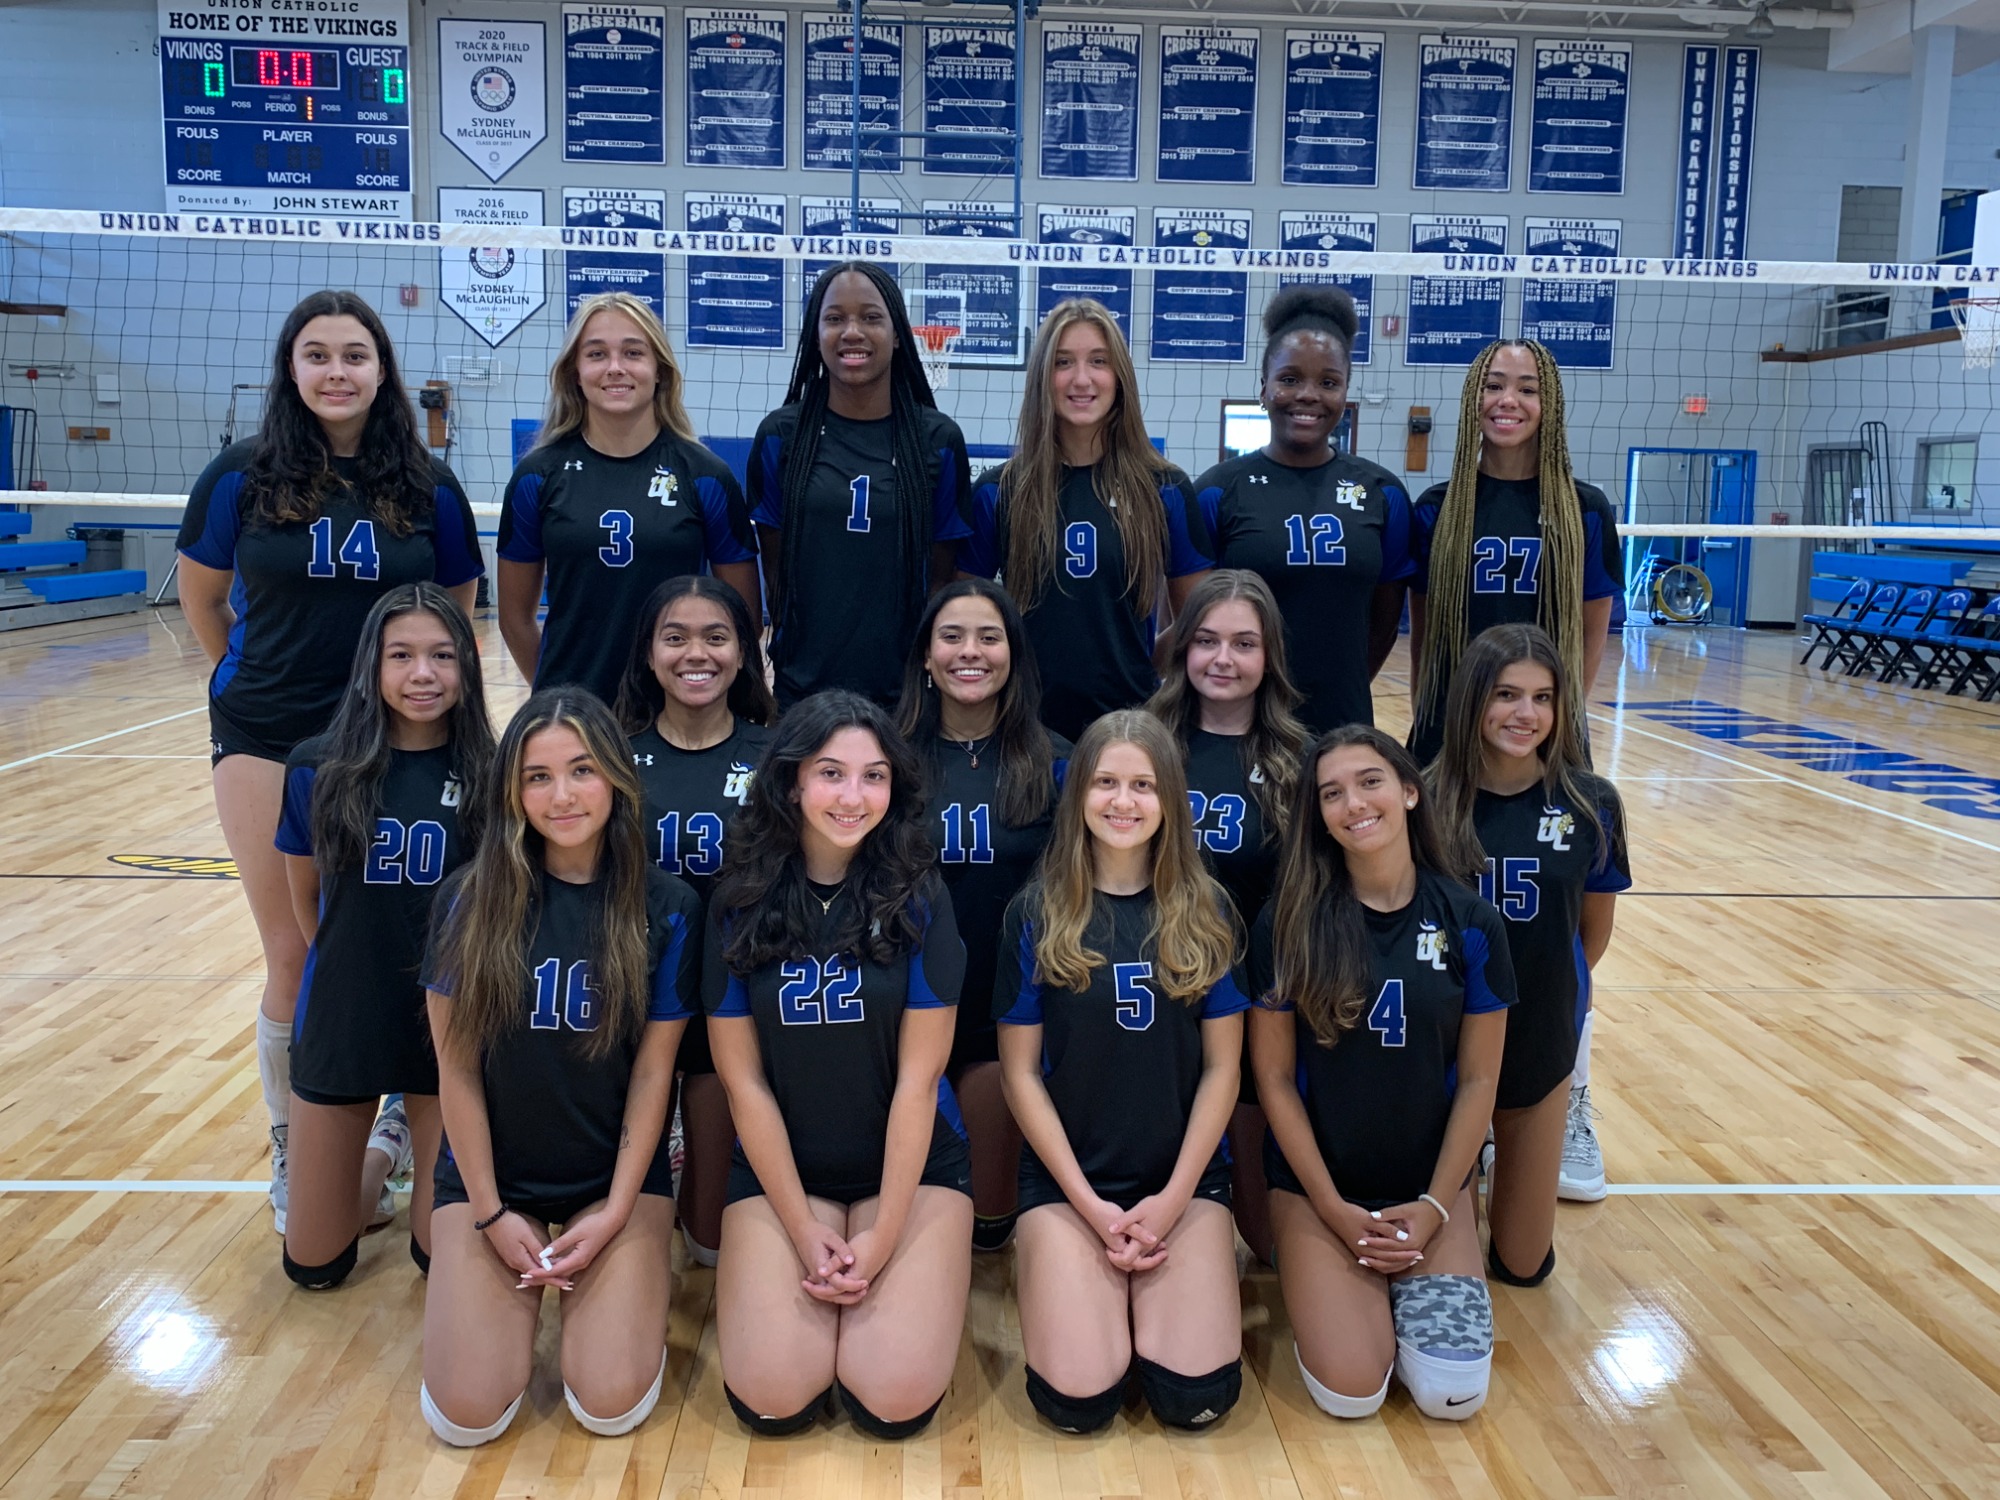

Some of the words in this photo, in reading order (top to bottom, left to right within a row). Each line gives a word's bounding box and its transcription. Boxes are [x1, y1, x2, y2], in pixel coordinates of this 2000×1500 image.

[208, 0, 262, 9] UNION
[271, 0, 359, 12] CATHOLIC
[169, 12, 229, 31] HOME
[236, 15, 263, 32] OF
[269, 16, 308, 33] THE
[314, 18, 398, 37] VIKINGS
[479, 30, 506, 40] 2020
[567, 14, 661, 39] BASEBALL
[690, 19, 783, 43] BASKETBALL
[807, 23, 900, 48] BASKEBALL
[166, 41, 223, 61] VIKINGS
[455, 41, 488, 51] TRACK
[491, 42, 500, 51] &
[503, 42, 530, 52] FIELD
[1047, 32, 1083, 52] CROSS
[1086, 33, 1138, 55] COUNTRY
[1165, 37, 1201, 57] CROSS
[1204, 38, 1255, 59] COUNTRY
[1290, 41, 1380, 60] GOLF
[346, 48, 402, 67] GUEST
[463, 53, 523, 63] OLYMPIAN
[1424, 46, 1513, 68] GYMNASTICS
[1538, 50, 1627, 74] SOCCER
[204, 63, 225, 97] 0
[384, 69, 404, 104] 0
[1690, 51, 1708, 132] UNION
[184, 106, 215, 116] BONUS
[231, 101, 251, 109] POSS
[265, 102, 297, 113] PERIOD
[321, 104, 341, 112] POSS
[357, 112, 388, 121] BONUS
[471, 118, 516, 128] SYDNEY
[177, 127, 219, 140] FOULS
[263, 129, 313, 143] PLAYER
[356, 133, 397, 145] FOULS
[457, 128, 531, 139] McLAUGHLIN
[1725, 52, 1748, 211] CHAMPIONSHIP
[177, 169, 222, 181] SCORE
[267, 172, 311, 184] MATCH
[356, 174, 399, 187] SCORE
[178, 195, 228, 205] Donated
[234, 197, 251, 207] By:
[273, 196, 316, 210] JOHN
[322, 198, 399, 211] STEWART
[454, 209, 487, 218] TRACK
[490, 210, 499, 218] &
[501, 210, 529, 219] FIELD
[478, 198, 504, 208] 2016
[567, 198, 661, 222] SOCCER
[826, 199, 873, 207] VIKIGS
[690, 203, 782, 226] SOFTBALL
[806, 207, 835, 227] SPRING
[99, 212, 180, 232] UNION
[195, 216, 321, 236] CATHOLIC
[339, 220, 441, 240] VIKINGS
[1042, 215, 1132, 237] SWIMMING
[1159, 219, 1248, 240] TENNIS
[1284, 222, 1373, 244] VOLLEYBALL
[1415, 225, 1445, 246] WINTER
[1447, 226, 1473, 238] TRACK
[1481, 227, 1503, 246] FIELD
[561, 228, 638, 247] UNION
[653, 232, 776, 252] CATHOLIC
[791, 237, 892, 256] VIKINGS
[1529, 228, 1559, 248] WINTER
[1560, 229, 1586, 241] TRACK
[1595, 230, 1617, 249] FIELD
[1723, 217, 1739, 258] WAL
[1008, 244, 1083, 262] UNION
[1098, 247, 1216, 265] CATHOLIC
[1232, 250, 1330, 268] VIKINGS
[1443, 255, 1517, 272] UNION
[1531, 257, 1647, 275] CATHOLIC
[1662, 261, 1758, 277] VIKINGS
[1869, 264, 1941, 281] UNION
[1955, 267, 1999, 282] CAT
[456, 294, 530, 305] McLAUGHLIN
[470, 284, 514, 294] SYDNEY
[846, 474, 871, 533] 1
[307, 516, 380, 581] 14
[598, 509, 634, 568] 3
[1284, 513, 1346, 566] 12
[1065, 521, 1097, 579] 9
[1473, 536, 1543, 594] 27
[1188, 790, 1246, 854] 23
[656, 811, 724, 876] 13
[940, 803, 994, 864] 11
[364, 817, 447, 886] 20
[1476, 857, 1540, 922] 15
[530, 957, 602, 1033] 16
[778, 953, 865, 1026] 22
[1112, 961, 1155, 1032] 5
[1367, 978, 1407, 1047] 4
